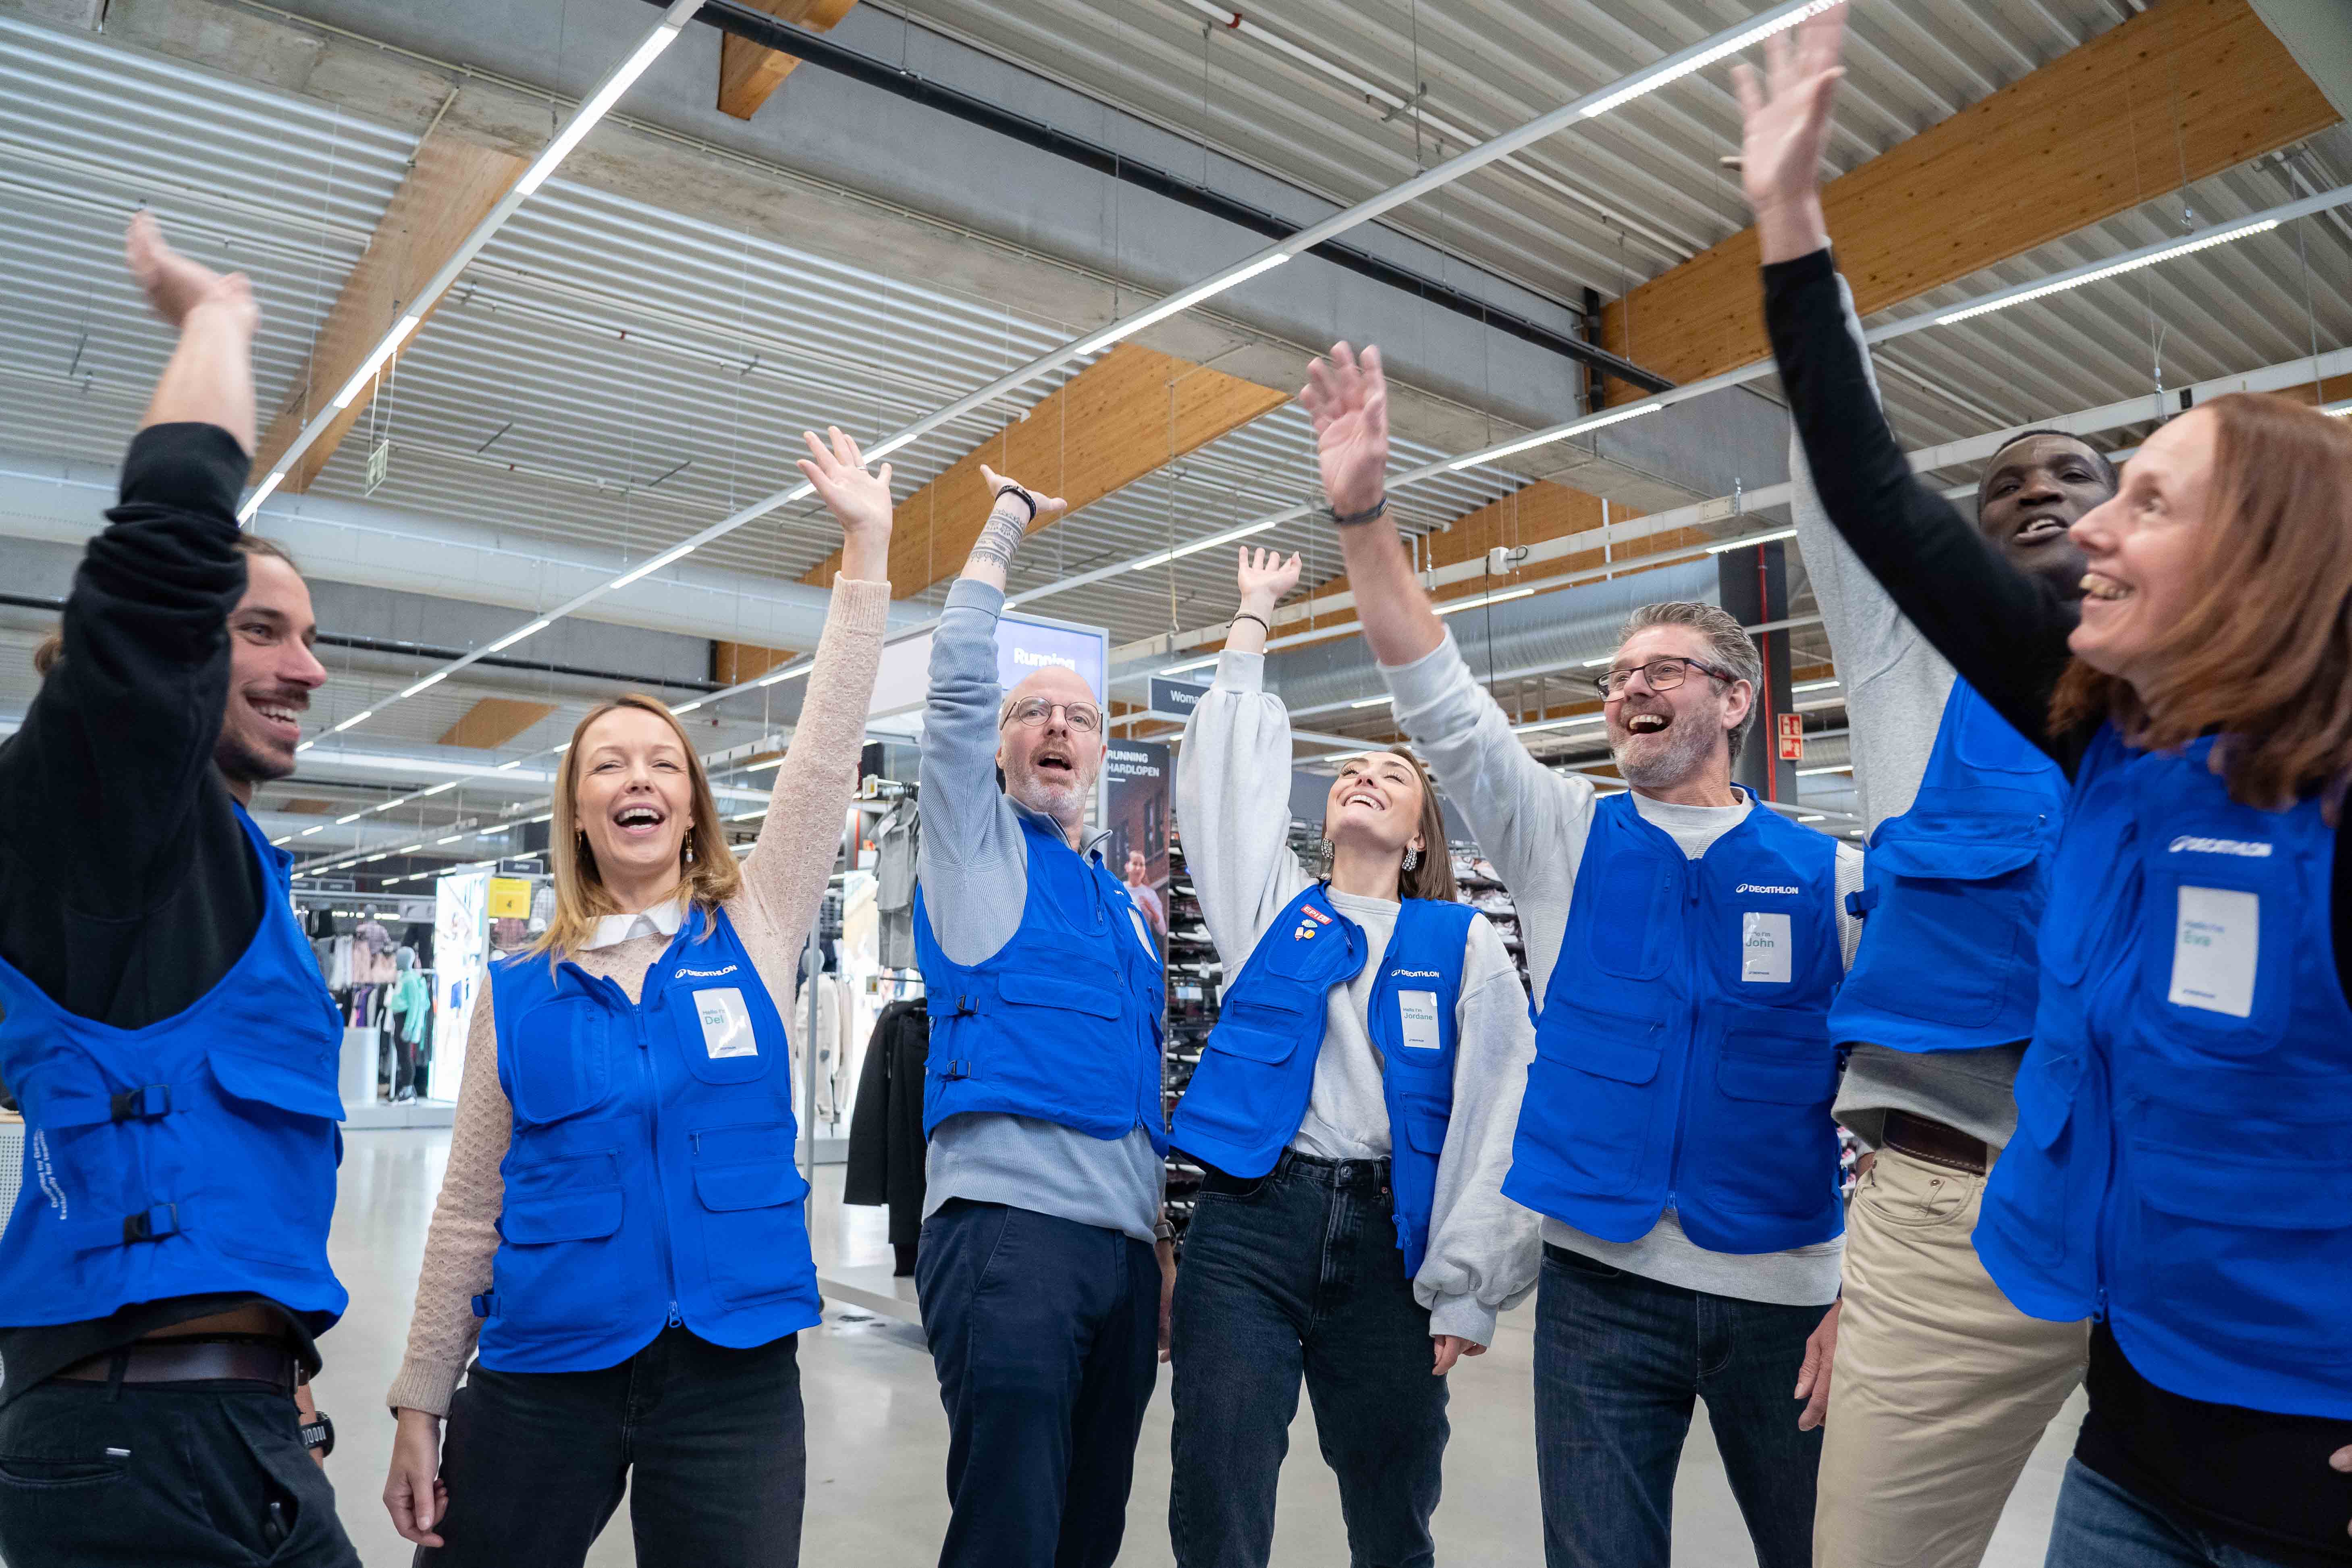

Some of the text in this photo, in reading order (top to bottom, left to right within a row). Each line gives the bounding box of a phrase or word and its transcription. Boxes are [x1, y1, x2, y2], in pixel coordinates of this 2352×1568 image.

[1170, 690, 1199, 704] Woma
[1107, 749, 1148, 764] RUNNING
[1107, 762, 1160, 777] HARDLOPEN
[1749, 885, 1799, 894] DECATHLON
[1745, 938, 1774, 947] John
[686, 965, 738, 976] DECATHLON
[1401, 969, 1439, 978] DECATHLON
[1404, 1013, 1433, 1021] Jordane
